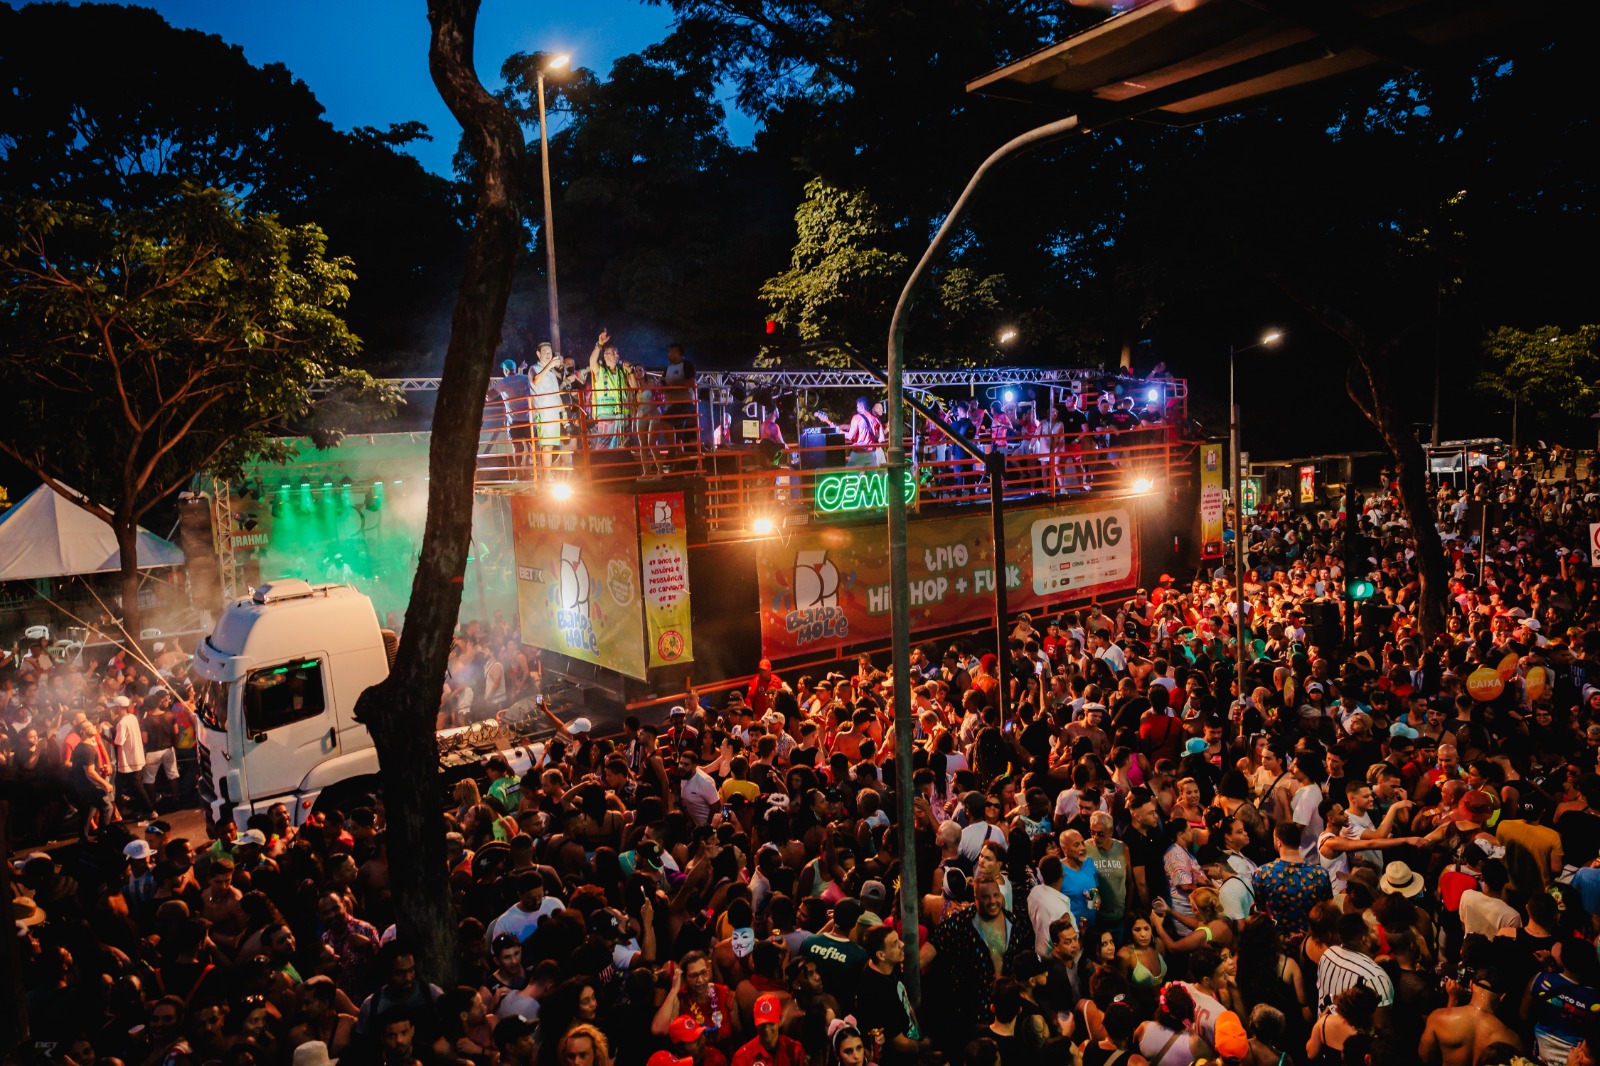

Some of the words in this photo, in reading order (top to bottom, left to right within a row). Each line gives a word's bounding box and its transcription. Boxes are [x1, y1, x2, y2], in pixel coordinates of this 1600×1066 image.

[231, 533, 269, 547] BRAHMA
[1041, 516, 1122, 557] CEMIG
[909, 577, 948, 605] HOP
[1469, 678, 1502, 689] CAIXA
[1093, 859, 1122, 868] HICAGO
[810, 943, 847, 963] crefisa
